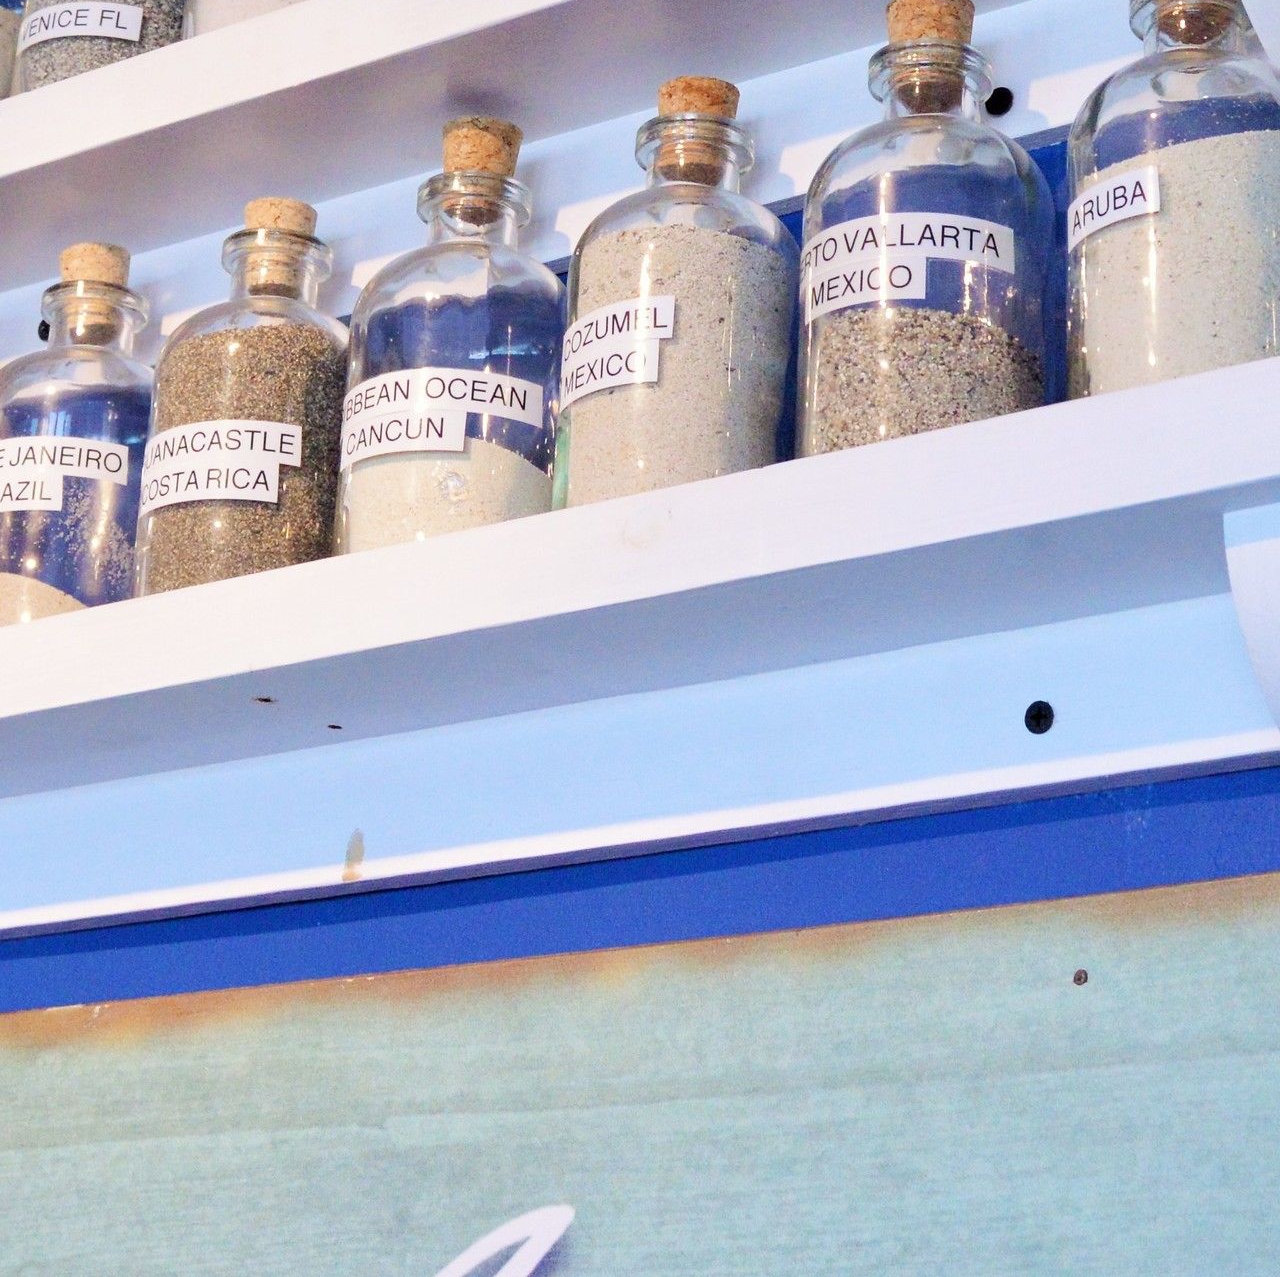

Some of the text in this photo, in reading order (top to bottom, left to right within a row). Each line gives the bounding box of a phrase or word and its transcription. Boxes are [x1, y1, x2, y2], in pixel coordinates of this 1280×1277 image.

[99, 9, 128, 30] FL
[1072, 180, 1147, 236] ARUBA
[425, 376, 528, 411] OCEAN
[346, 417, 445, 456] CANCUN
[9, 445, 123, 474] JANEIRO
[141, 468, 270, 506] COSTA RICA
